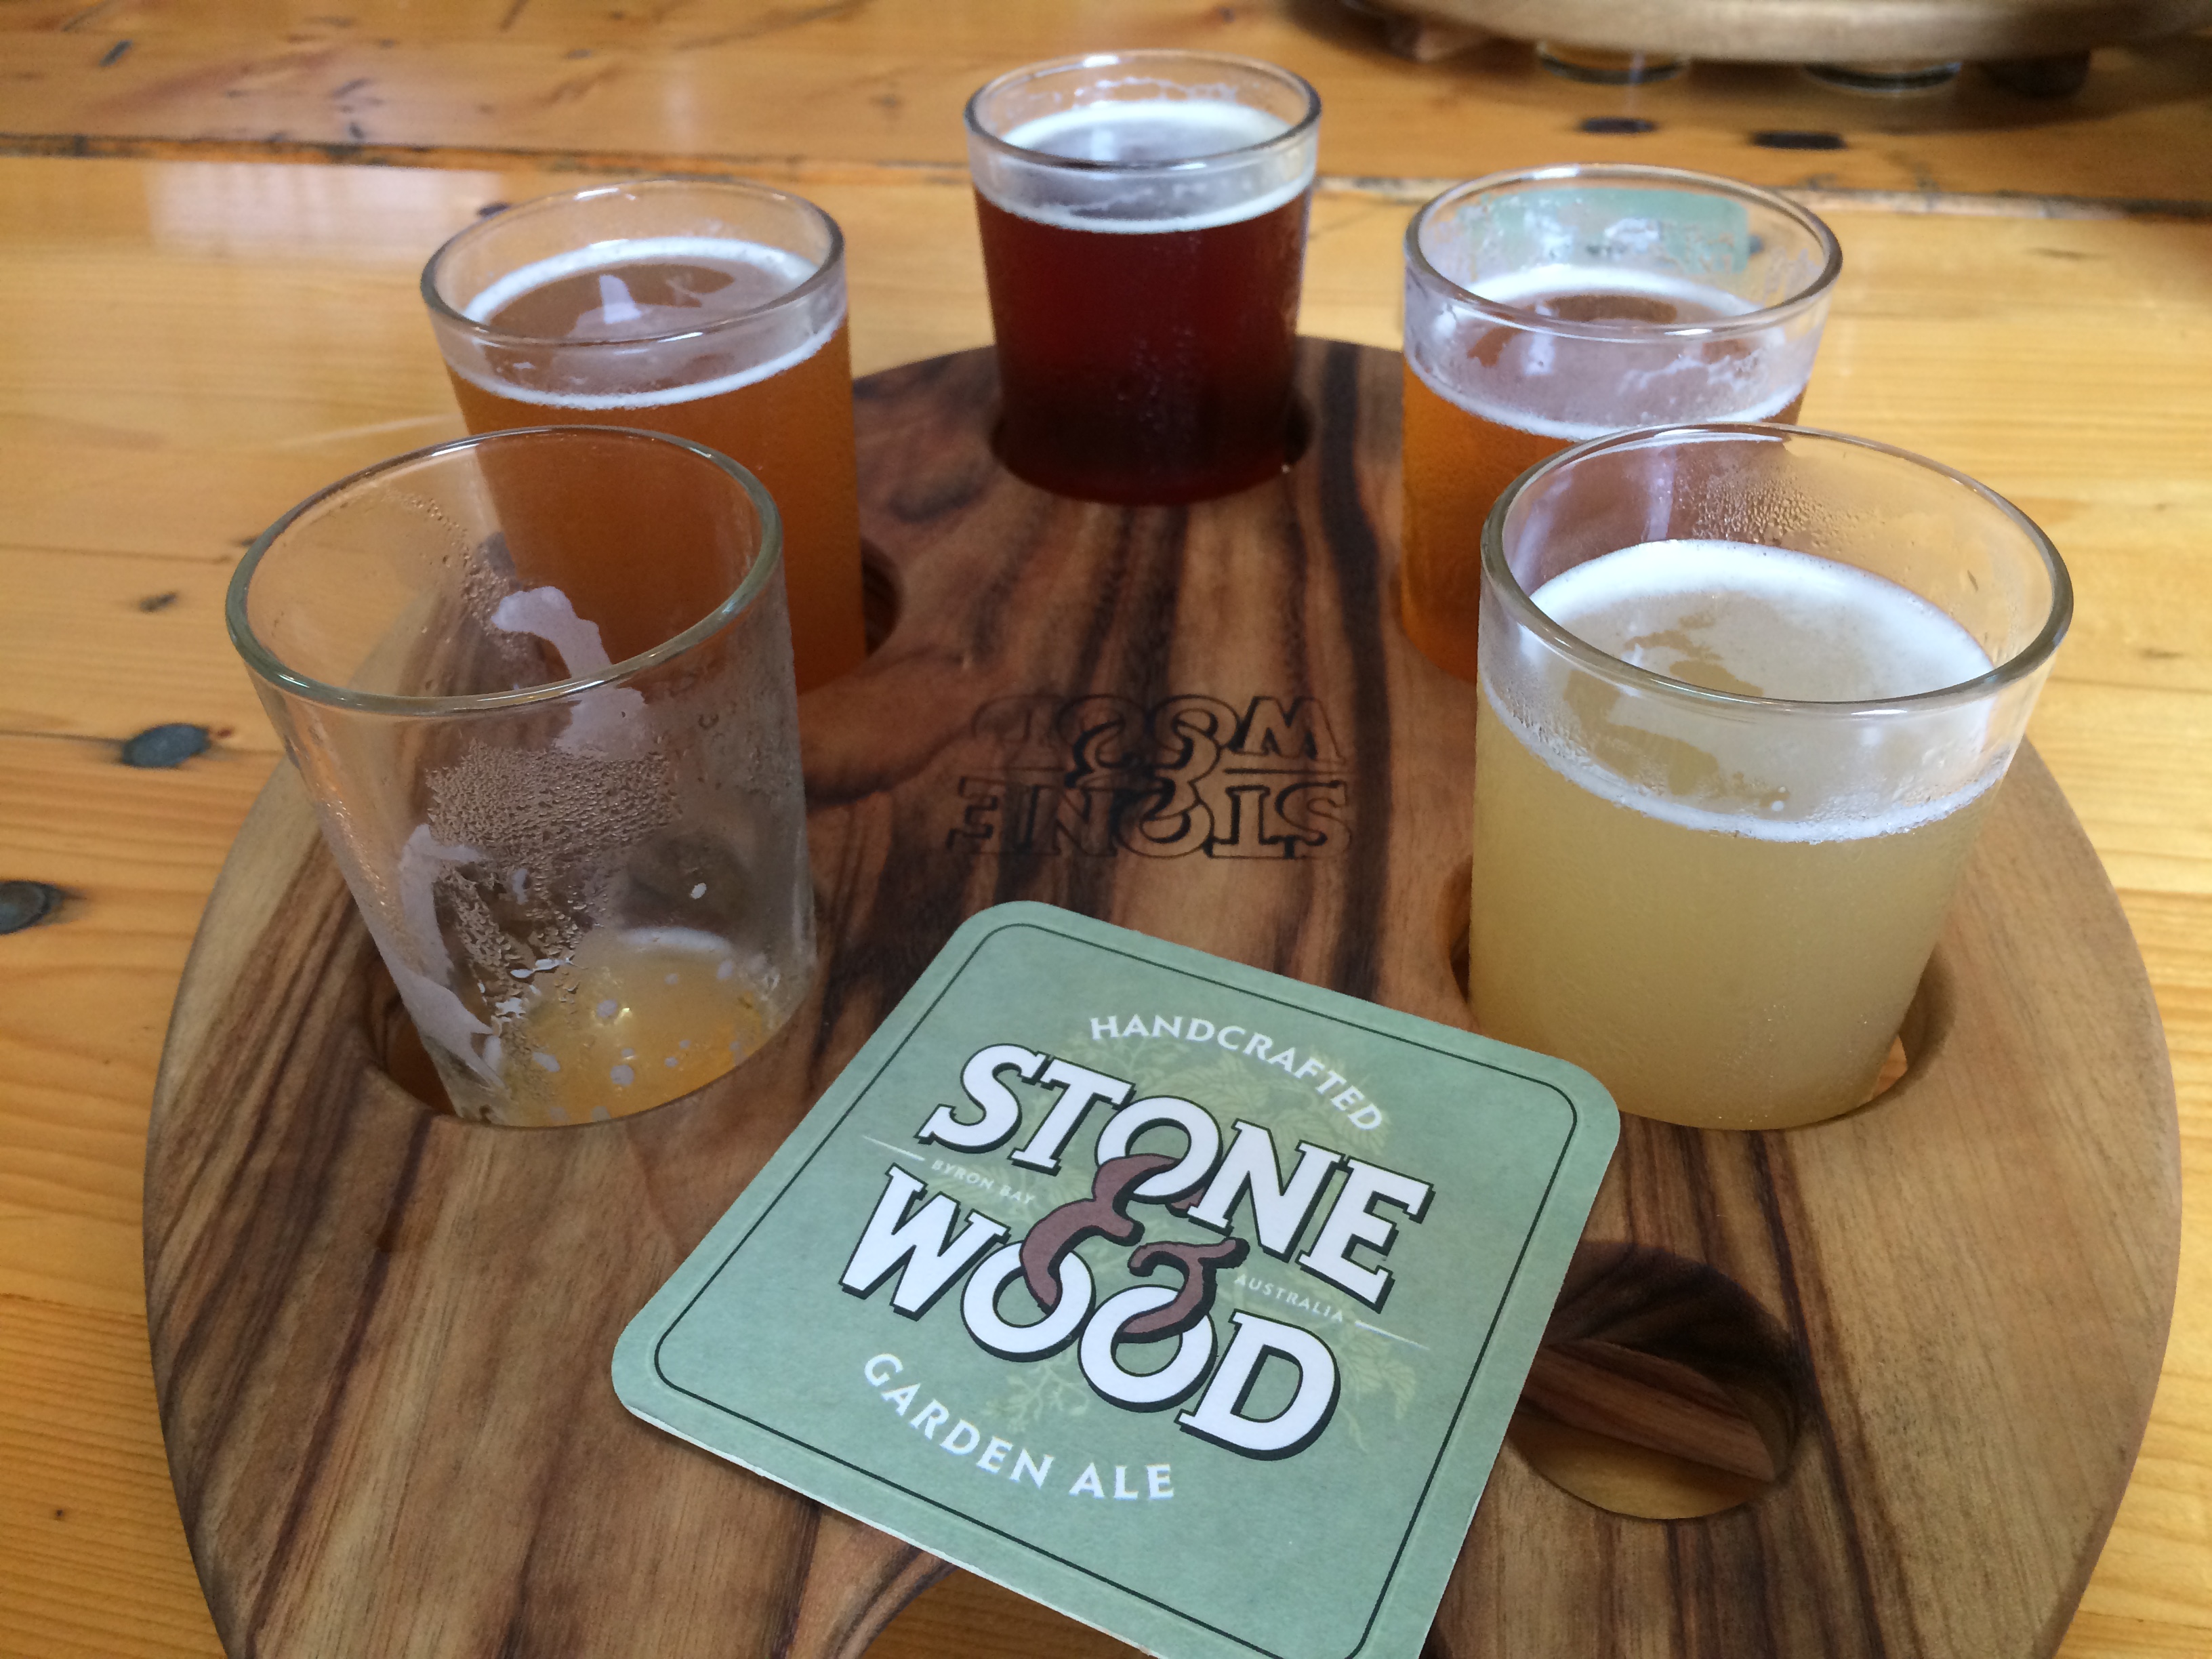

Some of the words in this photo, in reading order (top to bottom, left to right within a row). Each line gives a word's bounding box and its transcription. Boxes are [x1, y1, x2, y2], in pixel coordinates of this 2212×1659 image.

[972, 693, 1347, 764] WOOD
[945, 777, 1351, 859] STONE
[1090, 1014, 1384, 1134] HANDCRAFTED
[915, 1042, 1434, 1313] STONE
[931, 1159, 995, 1189] BYRON
[999, 1184, 1036, 1204] BAY
[840, 1163, 1342, 1461] WOOD
[1233, 1273, 1344, 1322] AUSTRALIA
[863, 1352, 1054, 1490] GARDEN
[1069, 1462, 1175, 1500] ALE
